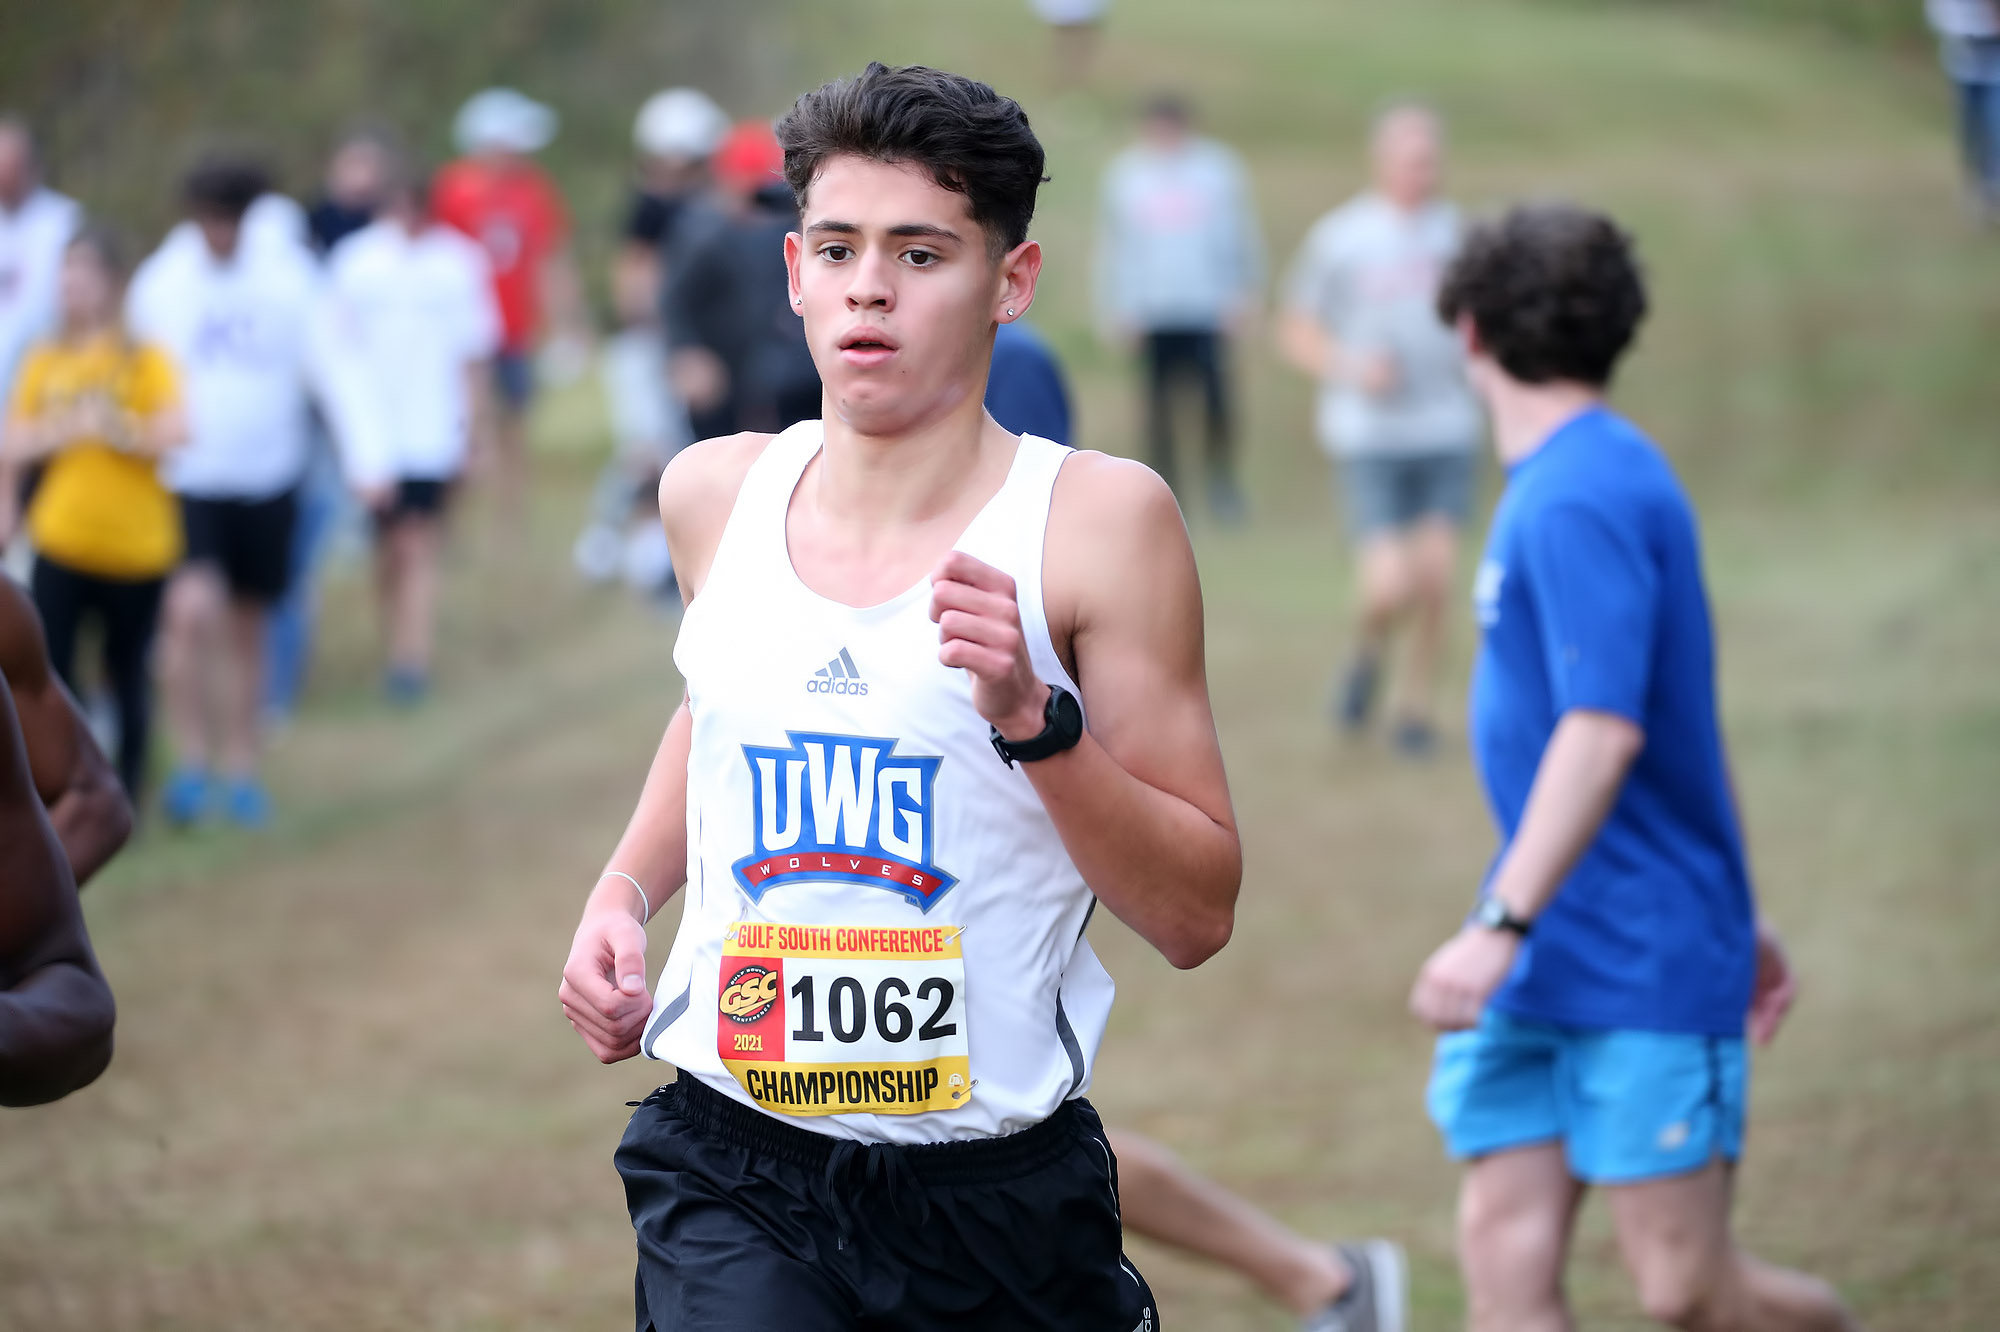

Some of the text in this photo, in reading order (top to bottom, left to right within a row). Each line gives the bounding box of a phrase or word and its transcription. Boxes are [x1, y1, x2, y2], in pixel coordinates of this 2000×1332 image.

[807, 677, 868, 695] adidas
[755, 742, 922, 864] UWG
[760, 857, 923, 886] WOLVES
[738, 925, 943, 953] GULF SOUTH CONFERENCE
[719, 971, 777, 1014] GSC
[791, 975, 957, 1043] 1062
[734, 1034, 763, 1052] 2021
[746, 1067, 939, 1105] CHAMPIONSHIP
